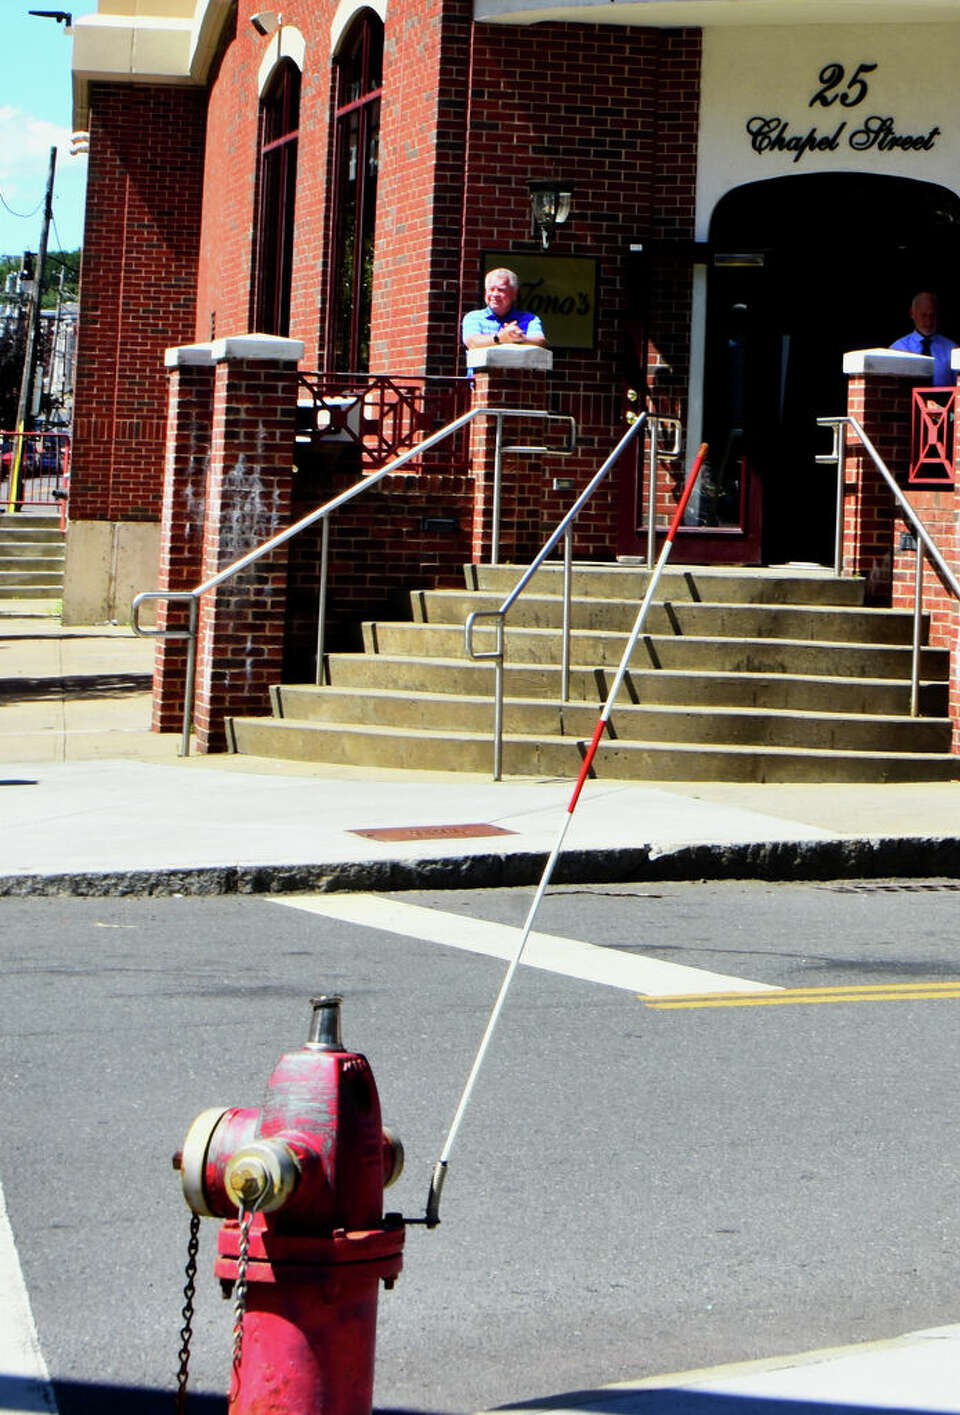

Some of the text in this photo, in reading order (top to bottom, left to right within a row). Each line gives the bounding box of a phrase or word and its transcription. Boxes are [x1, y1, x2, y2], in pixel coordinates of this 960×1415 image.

[809, 63, 878, 110] 25
[746, 115, 943, 164] Chapel Street
